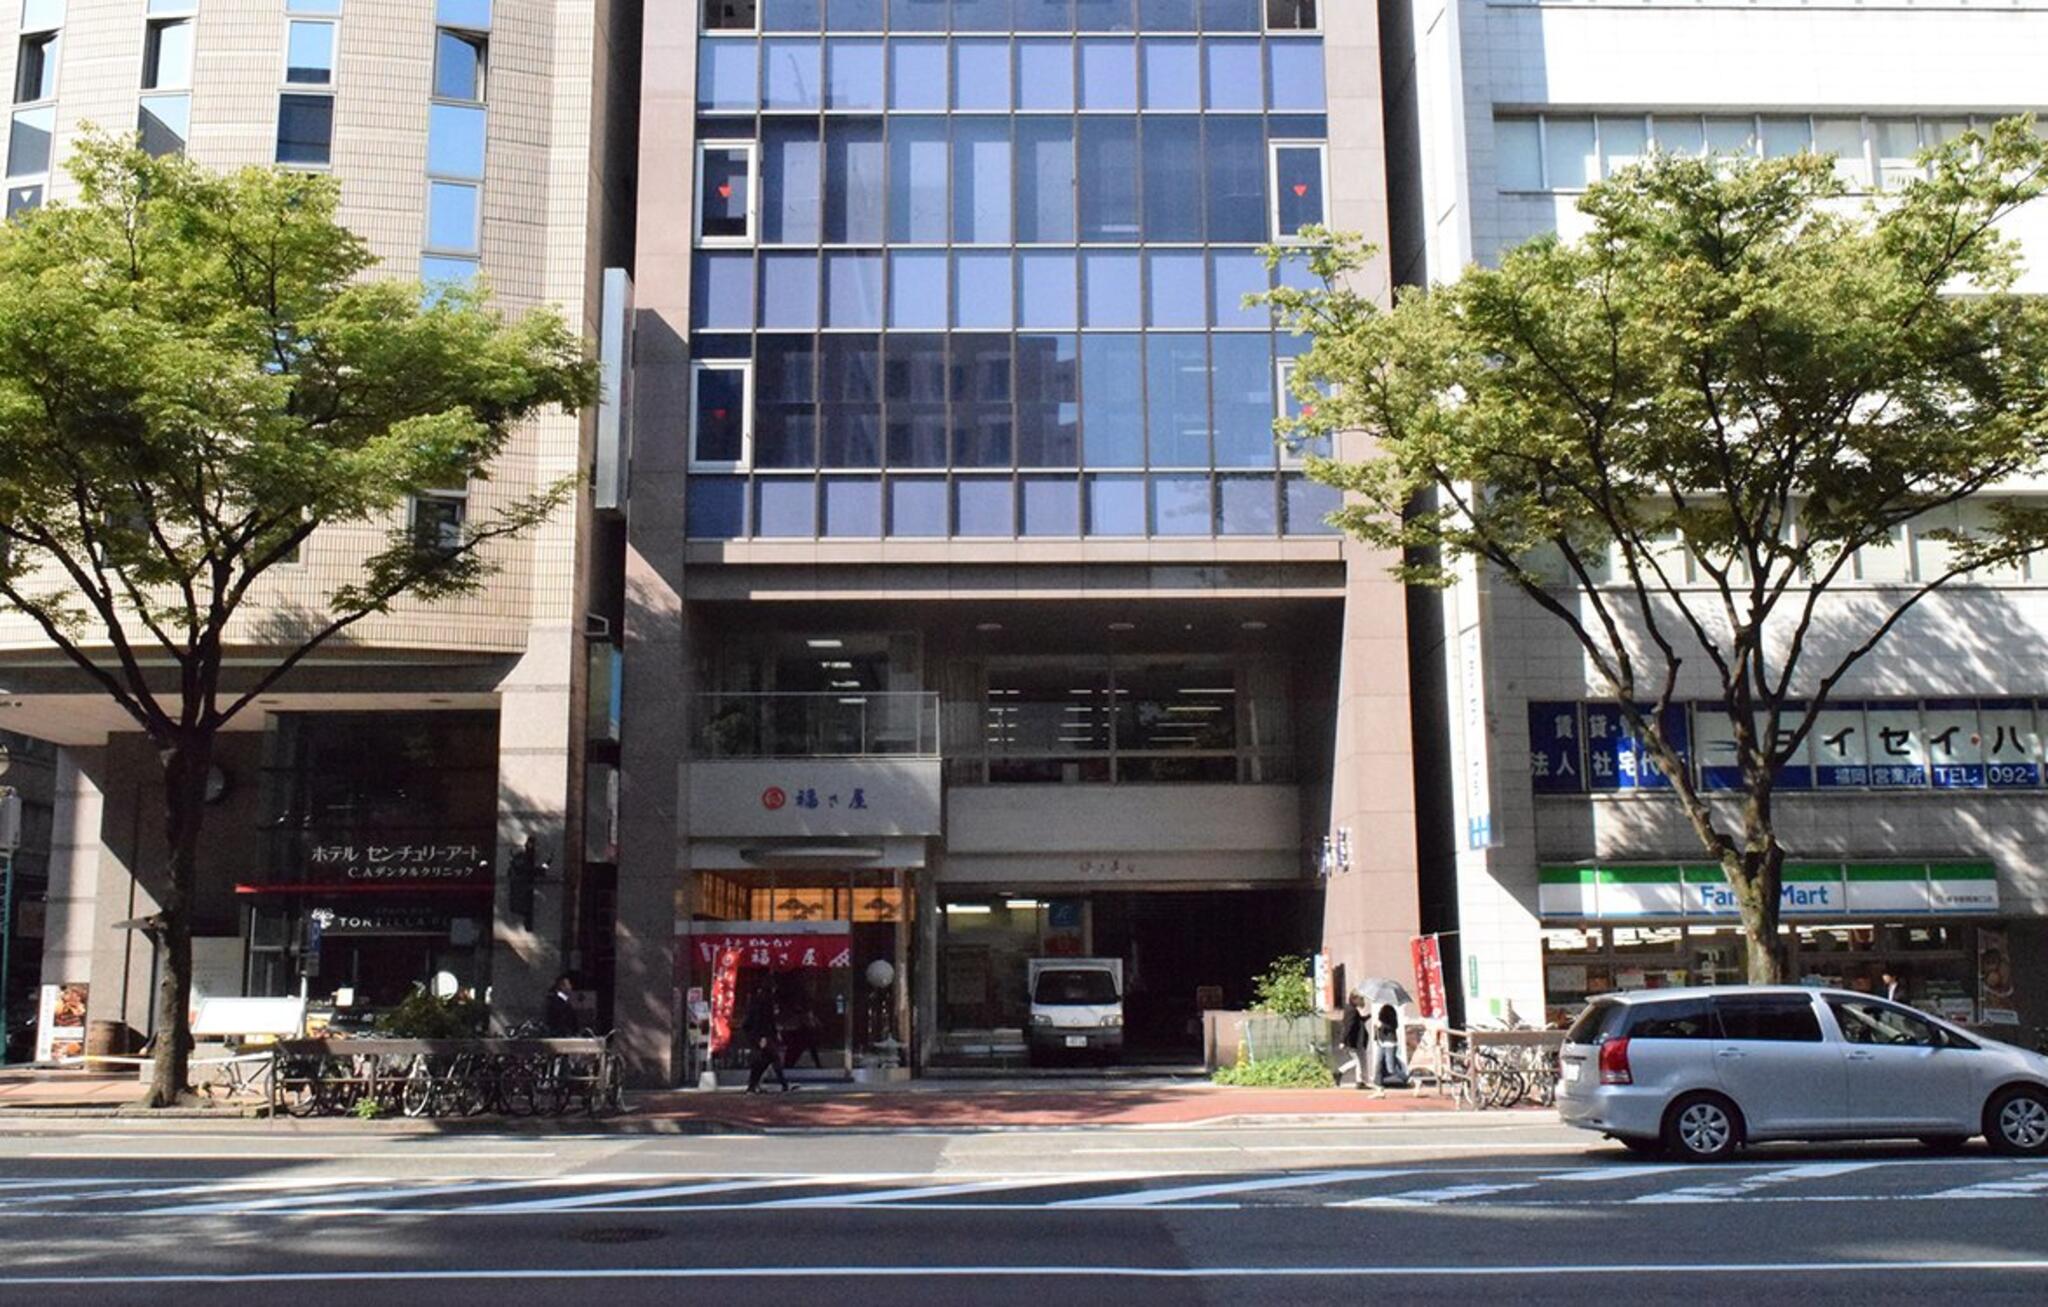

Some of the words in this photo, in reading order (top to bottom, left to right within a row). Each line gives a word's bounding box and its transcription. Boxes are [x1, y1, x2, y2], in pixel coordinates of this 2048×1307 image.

[796, 788, 868, 809] 福さ屋
[311, 846, 359, 862] ホテル
[366, 845, 479, 862] センチュリーアート
